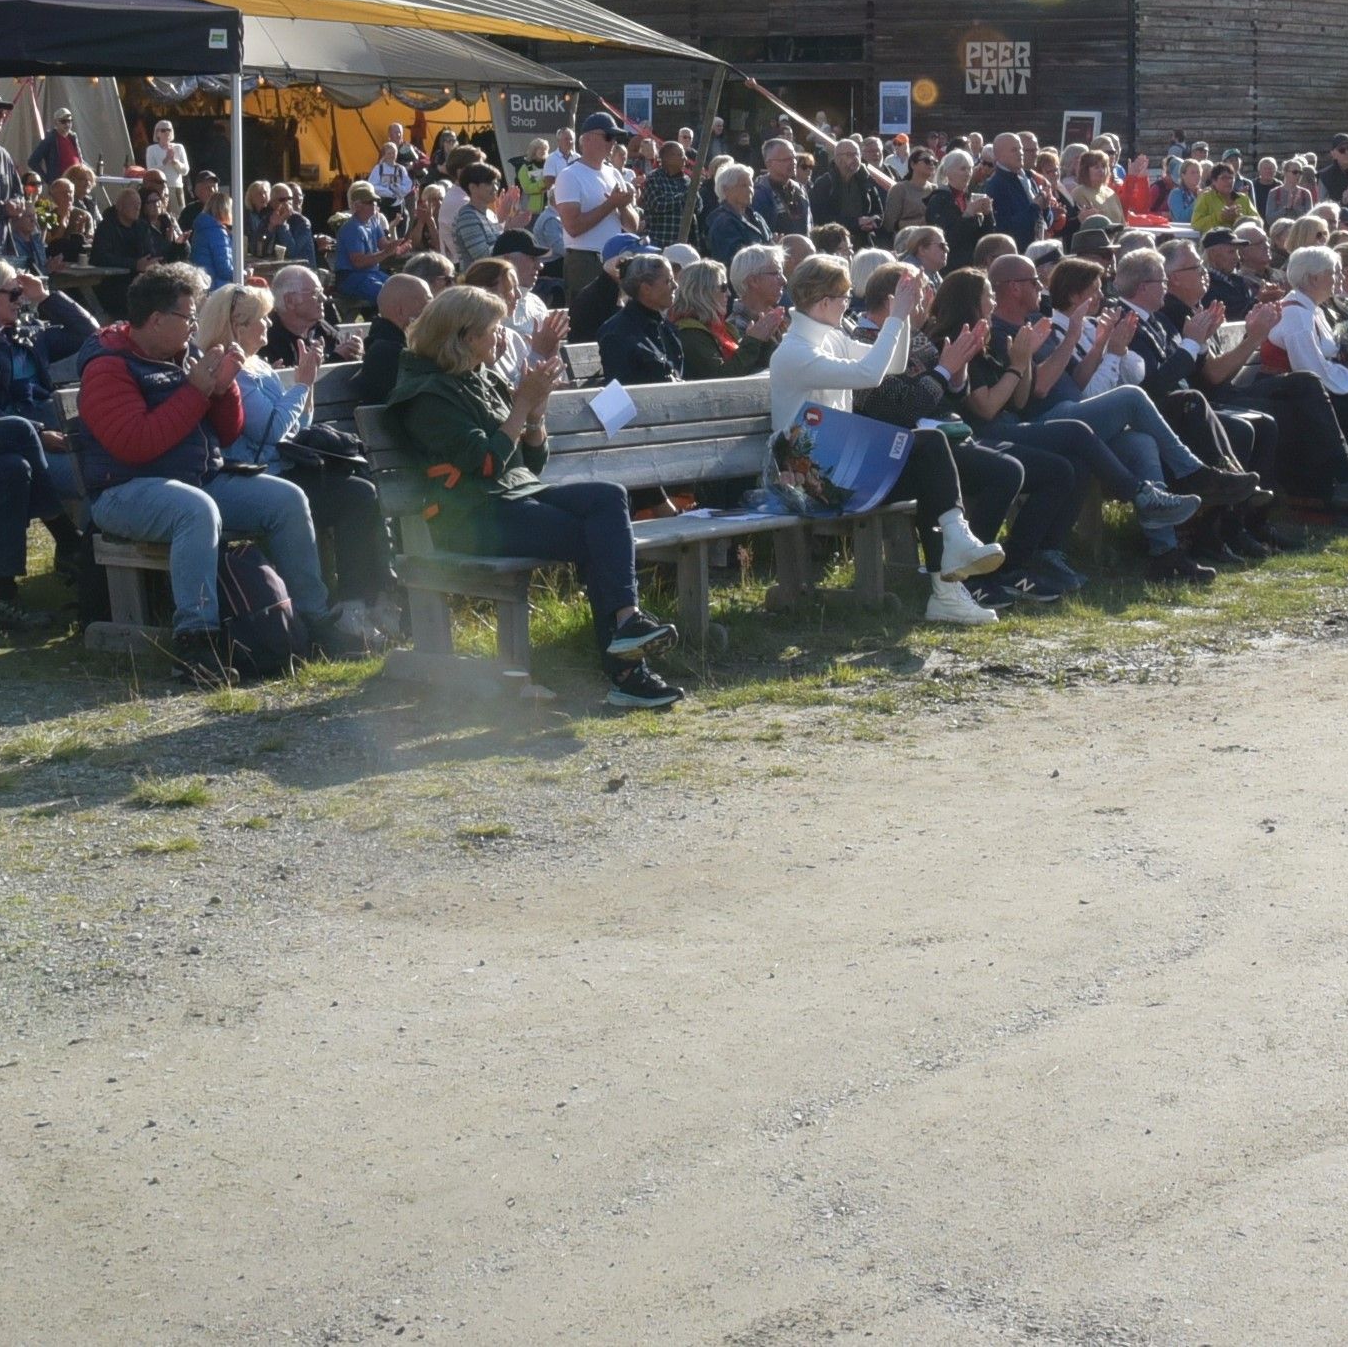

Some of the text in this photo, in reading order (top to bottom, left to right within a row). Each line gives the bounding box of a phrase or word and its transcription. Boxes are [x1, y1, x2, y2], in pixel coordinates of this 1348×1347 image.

[966, 41, 1031, 67] PEER
[965, 68, 1031, 94] GYNT
[511, 94, 565, 112] Butikk
[511, 116, 536, 128] Shop
[893, 435, 906, 454] VISA
